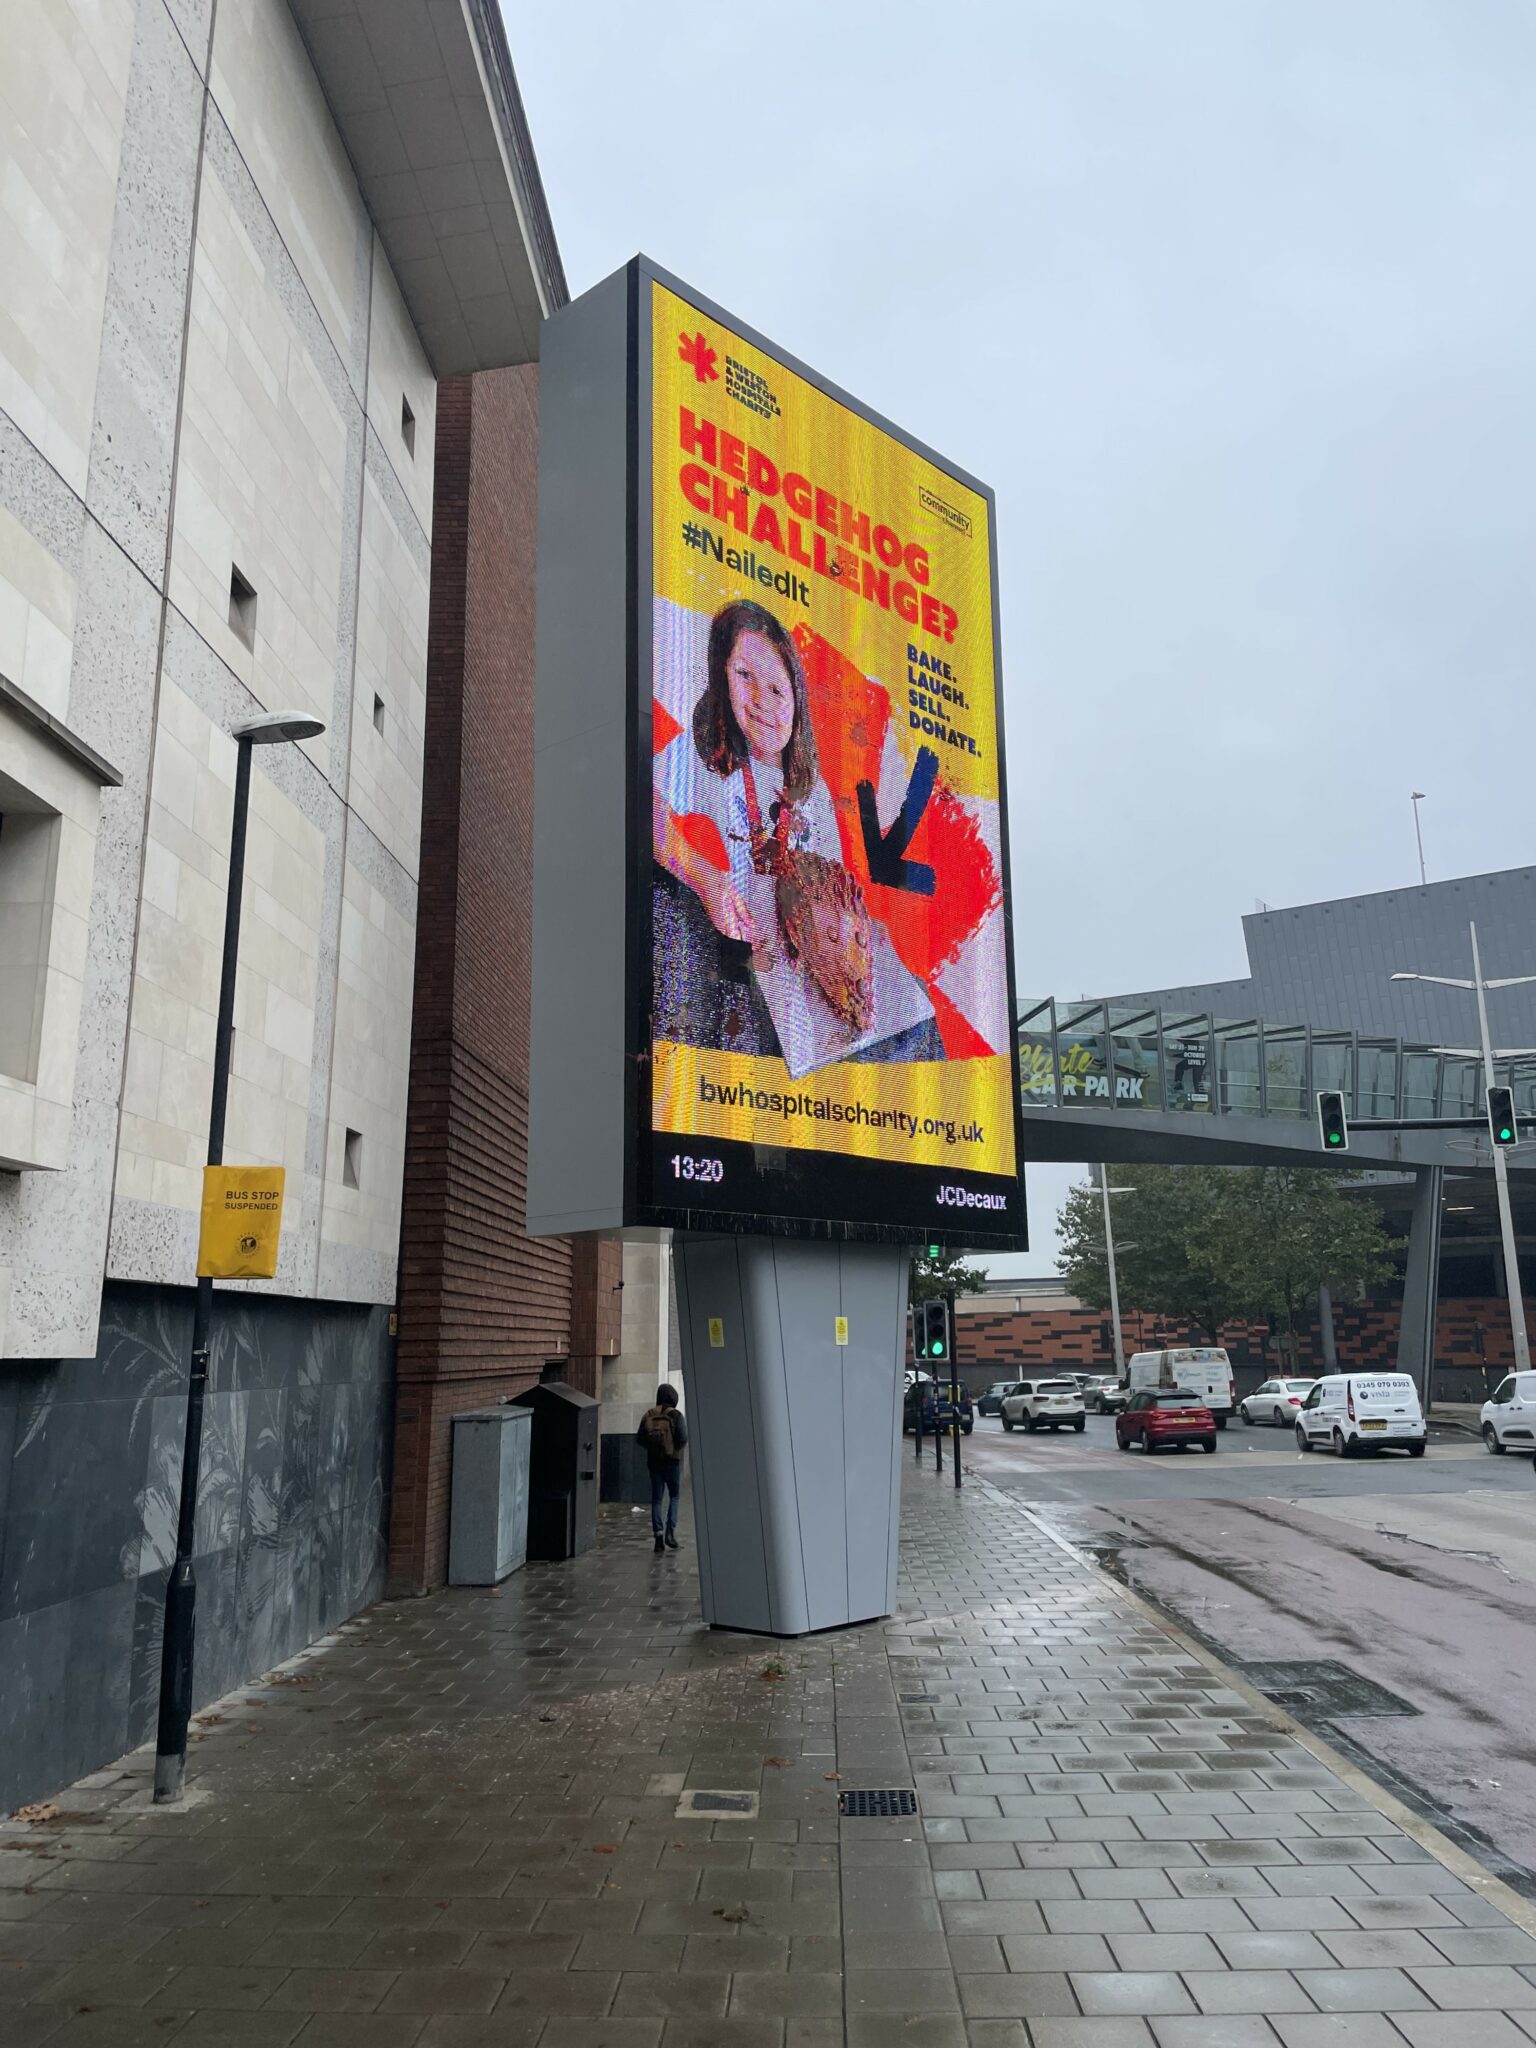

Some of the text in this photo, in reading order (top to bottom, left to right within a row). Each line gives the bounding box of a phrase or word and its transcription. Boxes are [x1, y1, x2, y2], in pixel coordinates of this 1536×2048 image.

[726, 355, 768, 390] BRISTOL
[735, 370, 777, 404] WESTON
[726, 375, 781, 417] HOSPITALS
[726, 386, 771, 419] CHARITY
[679, 405, 930, 587] HEDGEHOG
[921, 494, 970, 530] community
[679, 462, 959, 645] CHALLENGE?
[682, 519, 811, 607] #NailedIt
[907, 643, 957, 683] BAKE.
[908, 665, 970, 710] LAUGH.
[908, 688, 951, 722] SELL.
[909, 711, 982, 758] DONATE.
[1030, 1074, 1144, 1099] CAR PARK
[671, 1154, 724, 1182] 13:20
[224, 1202, 279, 1211] SUSPENDED
[226, 1191, 280, 1200] BUS STOP
[936, 1185, 1007, 1210] JCDecaux
